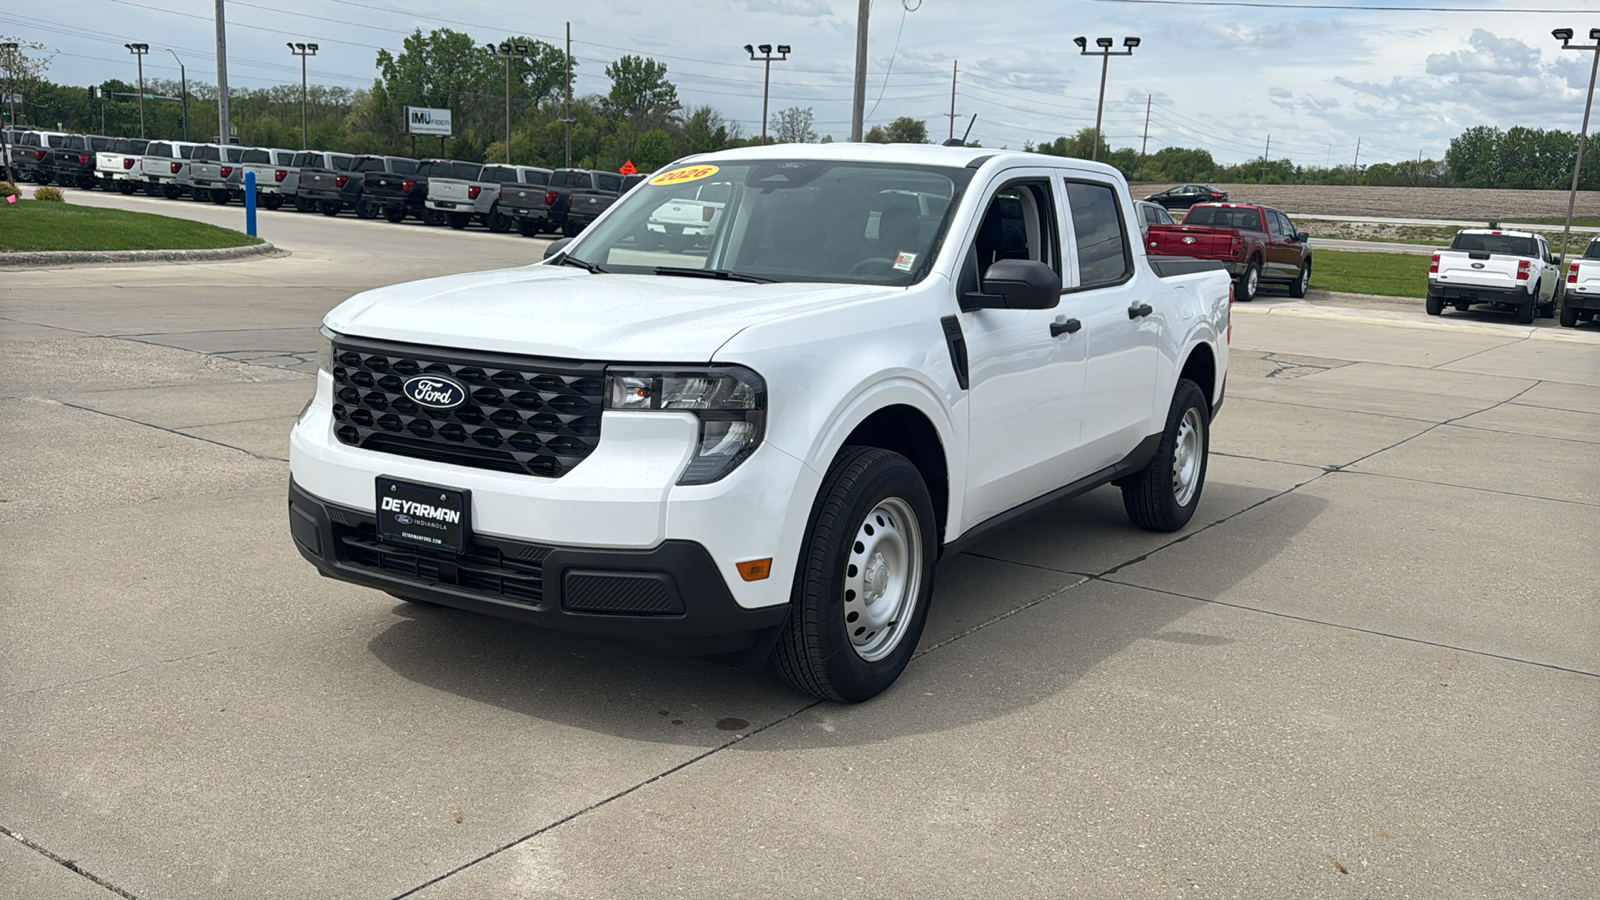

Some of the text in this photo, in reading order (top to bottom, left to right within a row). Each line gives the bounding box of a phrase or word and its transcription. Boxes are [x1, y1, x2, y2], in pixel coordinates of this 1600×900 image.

[412, 112, 430, 124] IMU
[654, 168, 712, 182] 2026
[414, 380, 452, 404] Ford
[382, 496, 460, 524] DEYARMAN
[414, 519, 447, 530] INDIANOLA
[402, 532, 442, 544] DEYARMANFORD.COM
